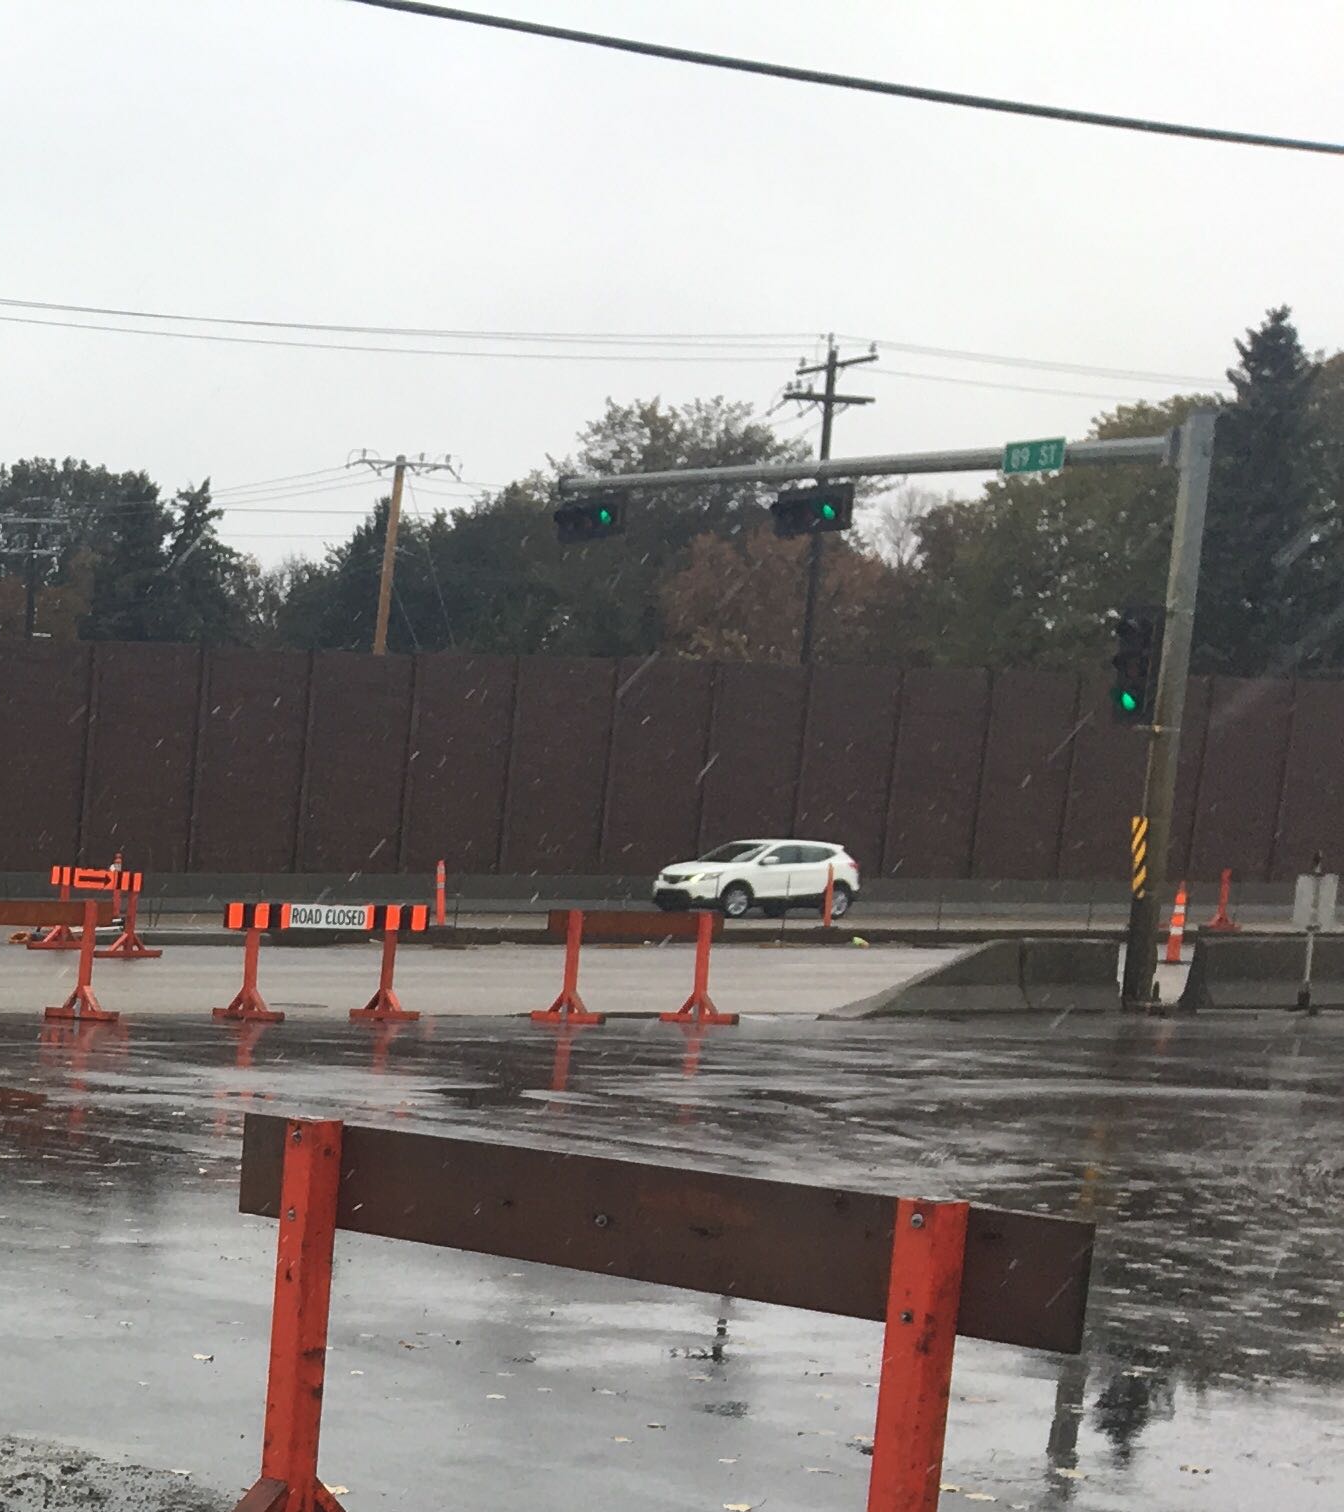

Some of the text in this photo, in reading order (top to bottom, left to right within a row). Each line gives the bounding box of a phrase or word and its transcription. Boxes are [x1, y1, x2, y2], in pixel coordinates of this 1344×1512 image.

[1038, 443, 1058, 466] ST
[291, 907, 366, 926] ROAD CLOSED
